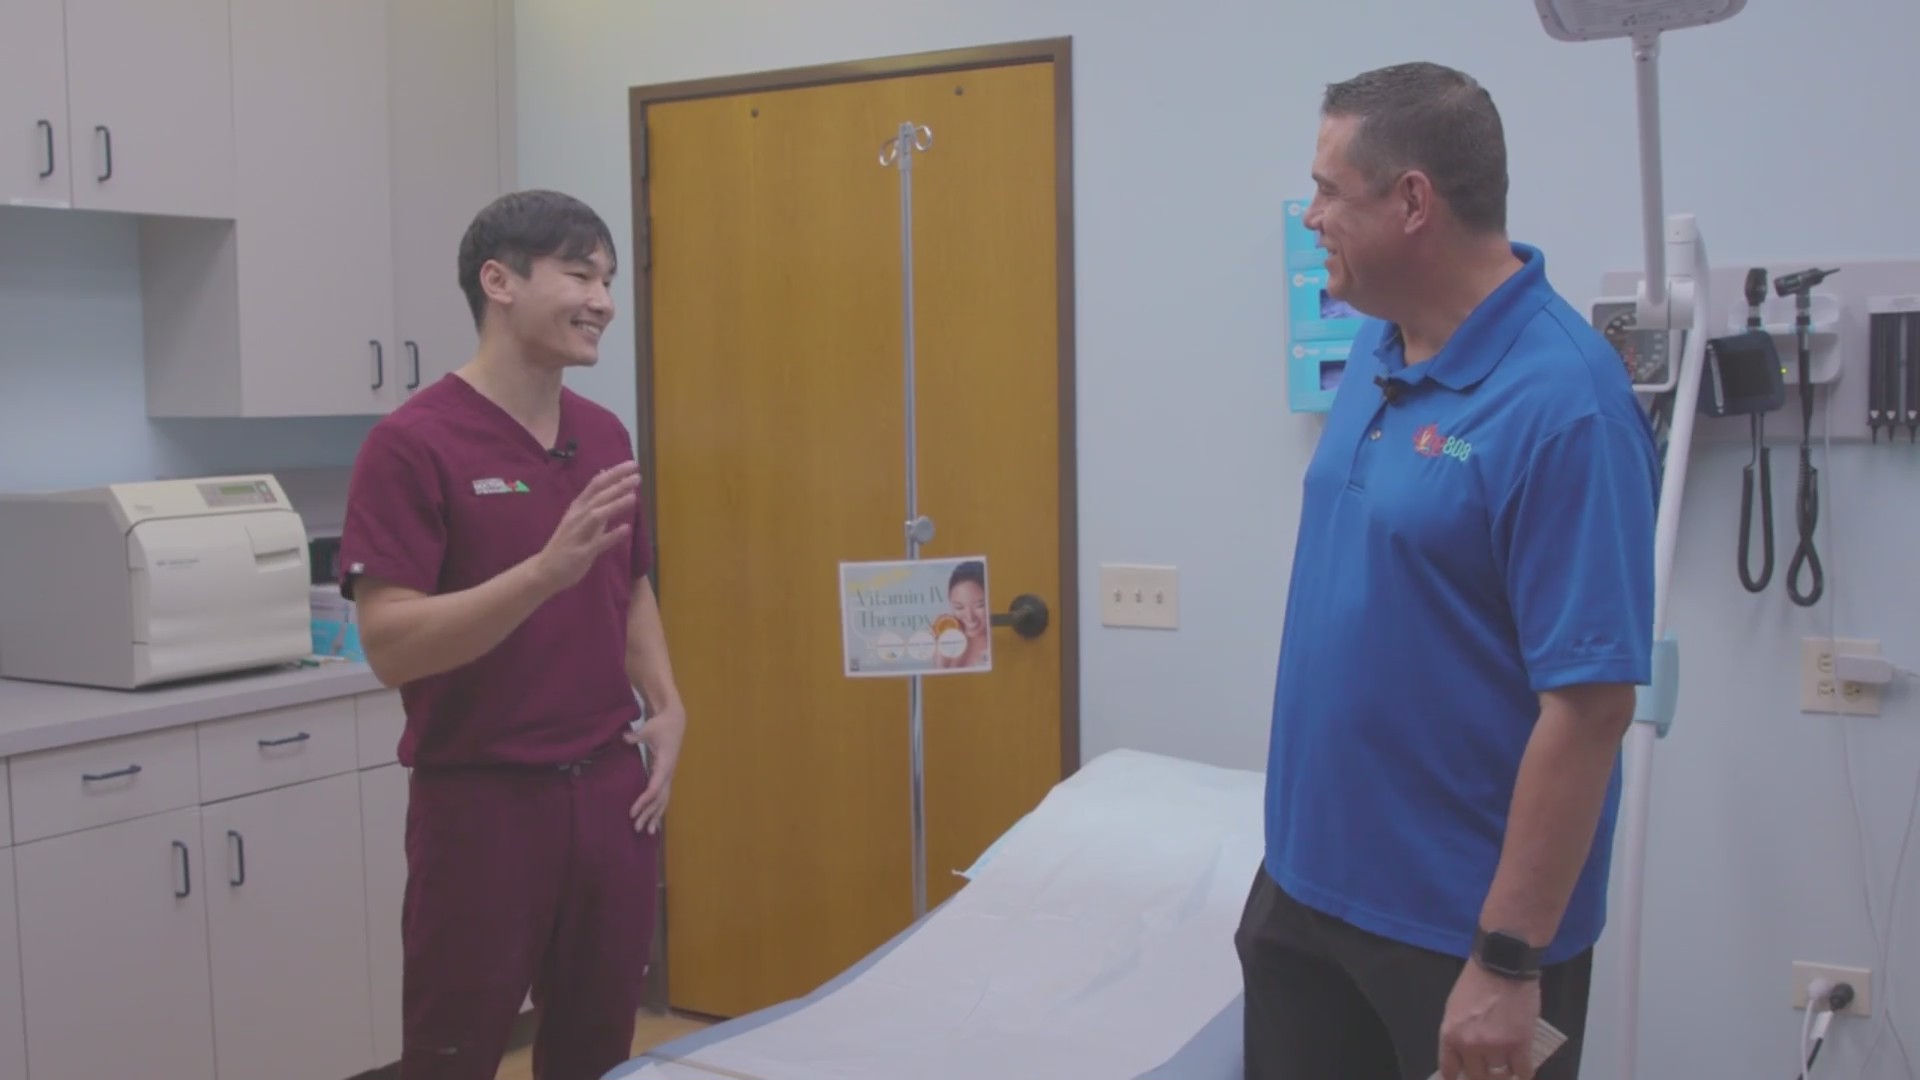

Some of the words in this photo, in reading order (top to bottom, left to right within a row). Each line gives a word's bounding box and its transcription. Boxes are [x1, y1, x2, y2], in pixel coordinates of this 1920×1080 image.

[856, 587, 925, 606] Vitamin
[929, 585, 946, 604] IV
[857, 608, 932, 631] Therapy
